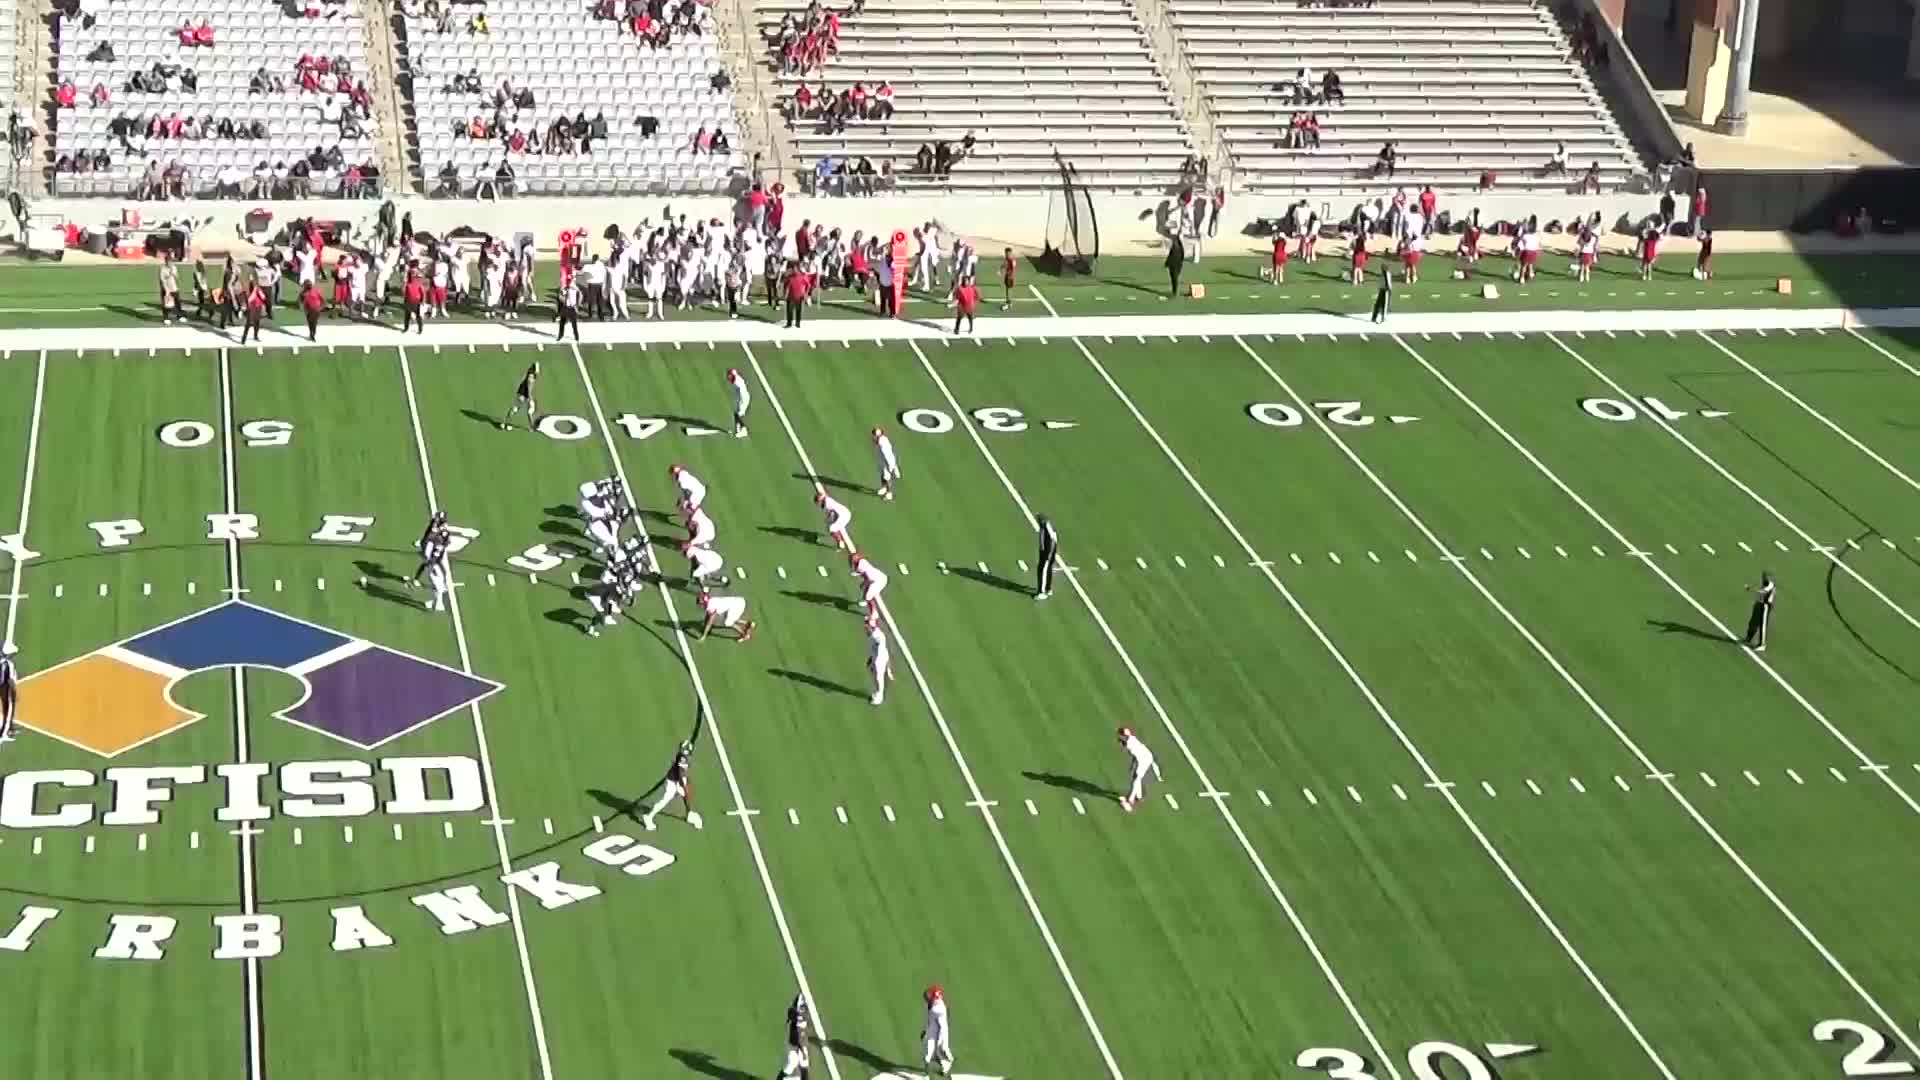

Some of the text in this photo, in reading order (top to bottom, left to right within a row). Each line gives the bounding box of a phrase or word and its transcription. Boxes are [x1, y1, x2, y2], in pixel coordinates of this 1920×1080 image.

[901, 406, 1028, 433] 30
[1249, 401, 1375, 427] 20
[1581, 397, 1688, 421] 10
[160, 420, 295, 447] 50
[537, 413, 667, 440] 40
[0, 756, 486, 829] CFISD
[0, 835, 676, 960] IRBANKS
[1813, 1019, 1920, 1076] 2
